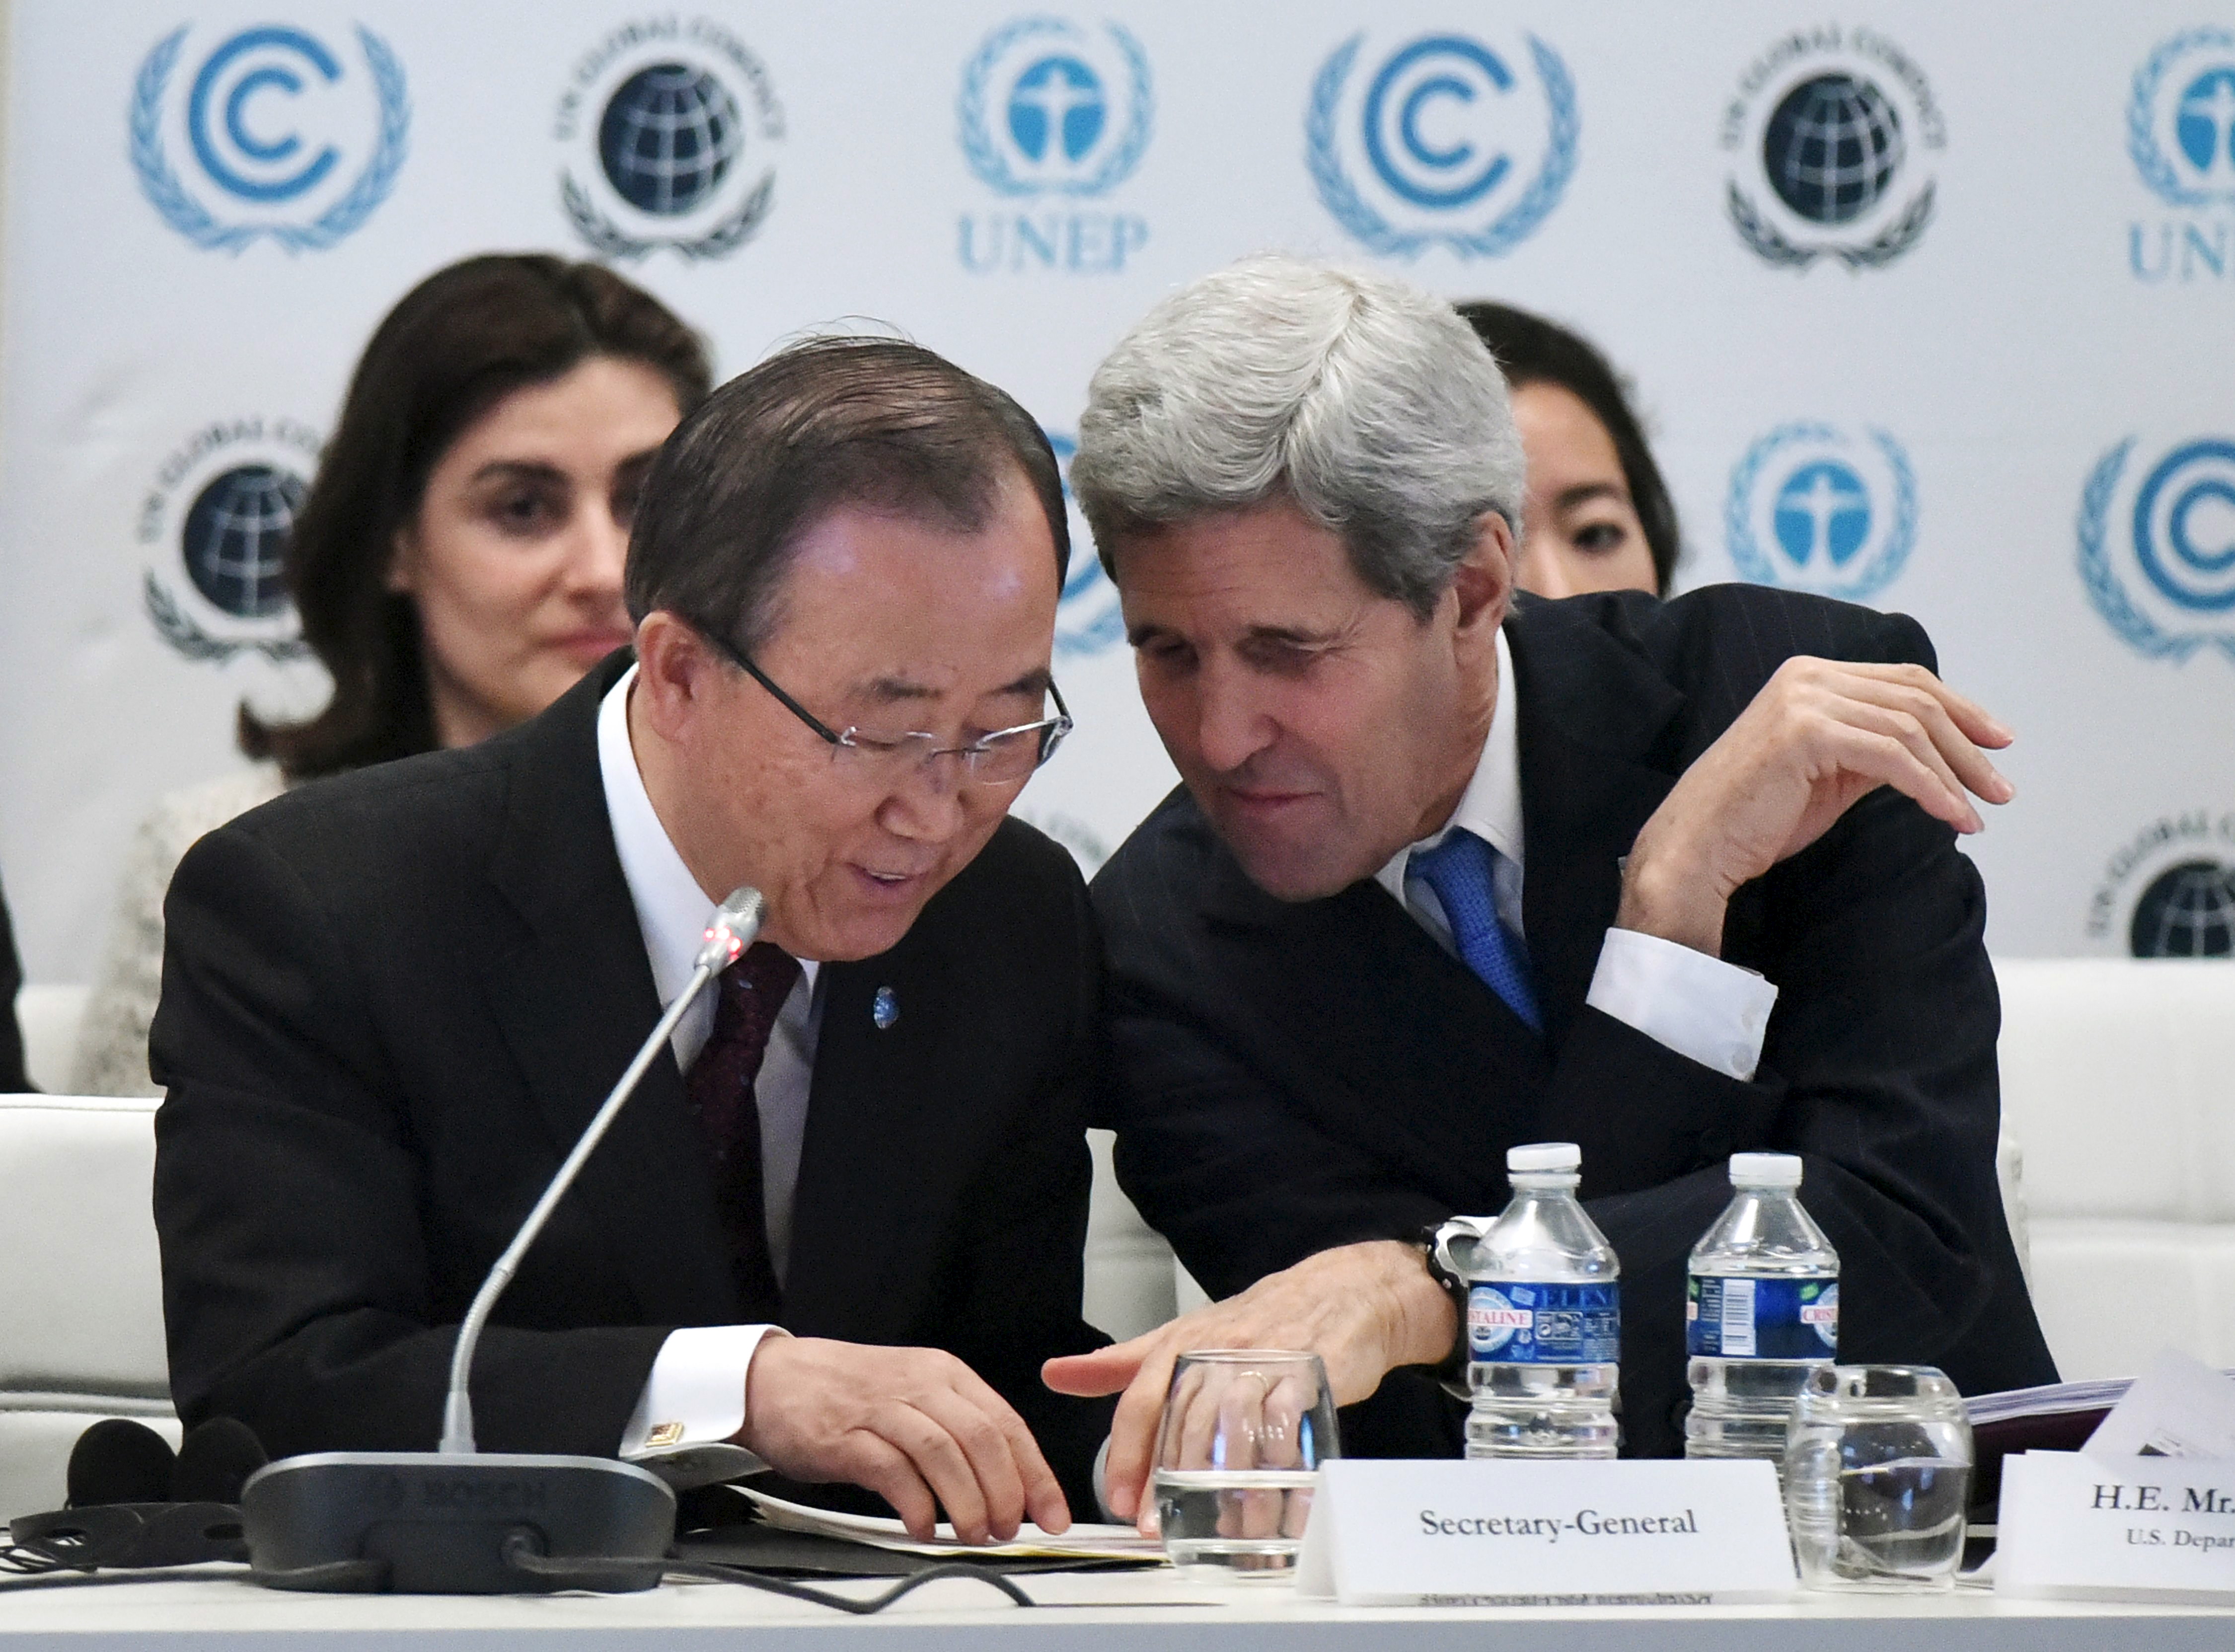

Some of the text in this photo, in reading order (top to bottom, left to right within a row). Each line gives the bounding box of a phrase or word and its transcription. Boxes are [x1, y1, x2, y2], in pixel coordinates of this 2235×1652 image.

[959, 213, 1150, 275] UNEP
[2090, 1484, 2235, 1513] H.E. Mr.
[1419, 1509, 1698, 1543] Secretary-General
[2127, 1528, 2166, 1545] U.S.
